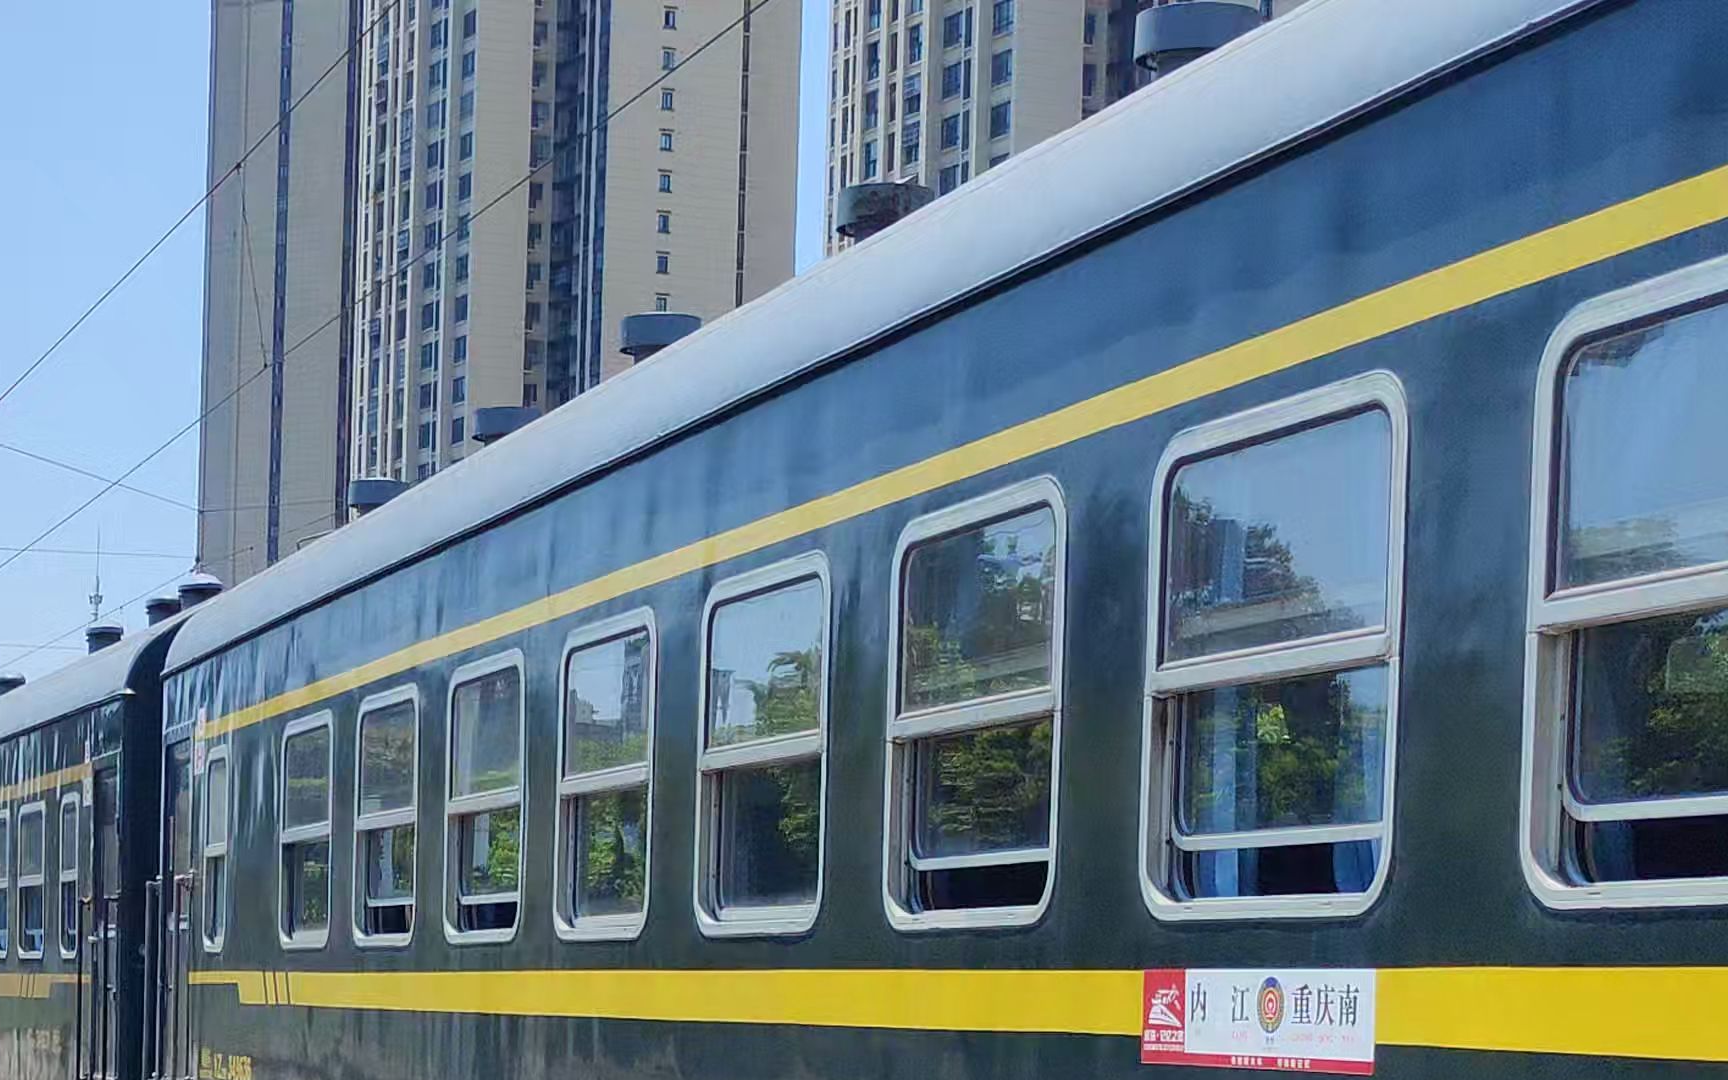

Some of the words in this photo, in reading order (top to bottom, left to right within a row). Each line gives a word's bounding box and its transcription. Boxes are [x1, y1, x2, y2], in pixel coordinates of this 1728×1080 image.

[1190, 982, 1250, 1023] 内江
[1290, 983, 1360, 1027] 重庆南
